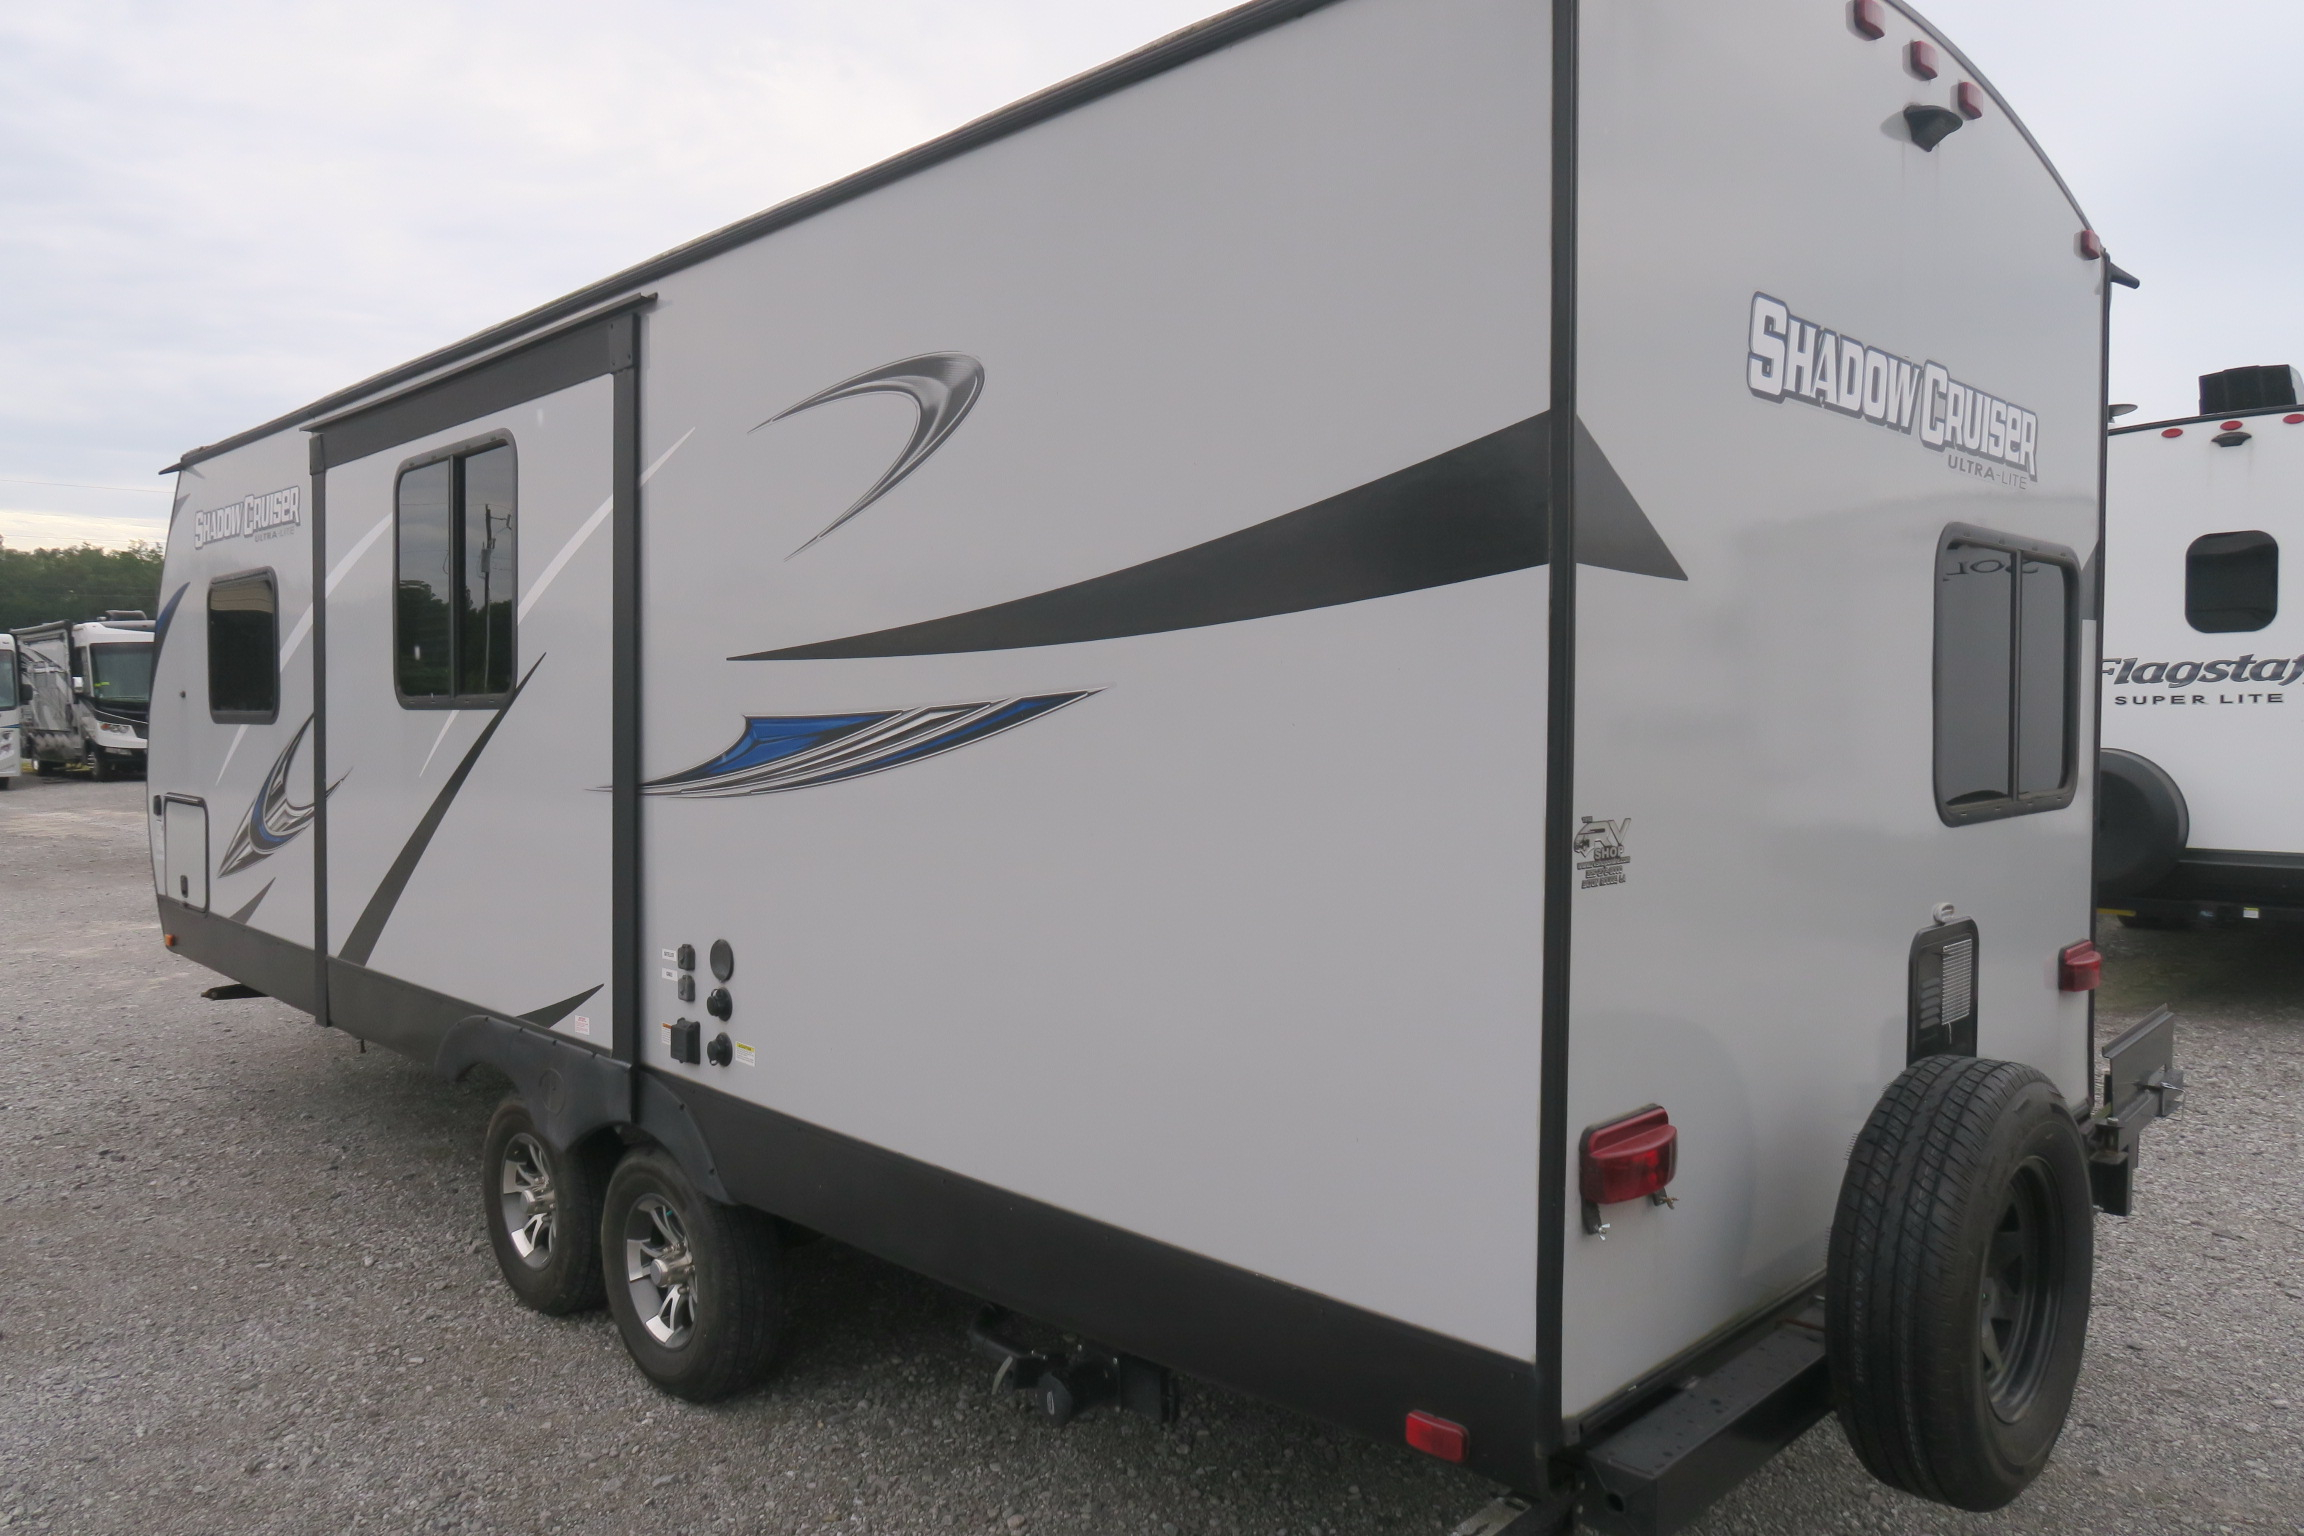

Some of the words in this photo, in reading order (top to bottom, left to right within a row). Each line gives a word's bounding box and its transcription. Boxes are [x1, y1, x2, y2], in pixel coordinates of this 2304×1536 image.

[1747, 291, 1923, 435] SHADOW
[1919, 359, 2038, 482] CRUISER
[1947, 454, 2028, 490] ULTRA-LITE
[195, 502, 244, 550] SHADOW
[244, 485, 300, 538] CRUISER
[2102, 653, 2304, 688] Flagstaf
[2114, 694, 2207, 706] SUPER
[2220, 692, 2285, 705] LITE
[1594, 845, 1624, 860] SHOP
